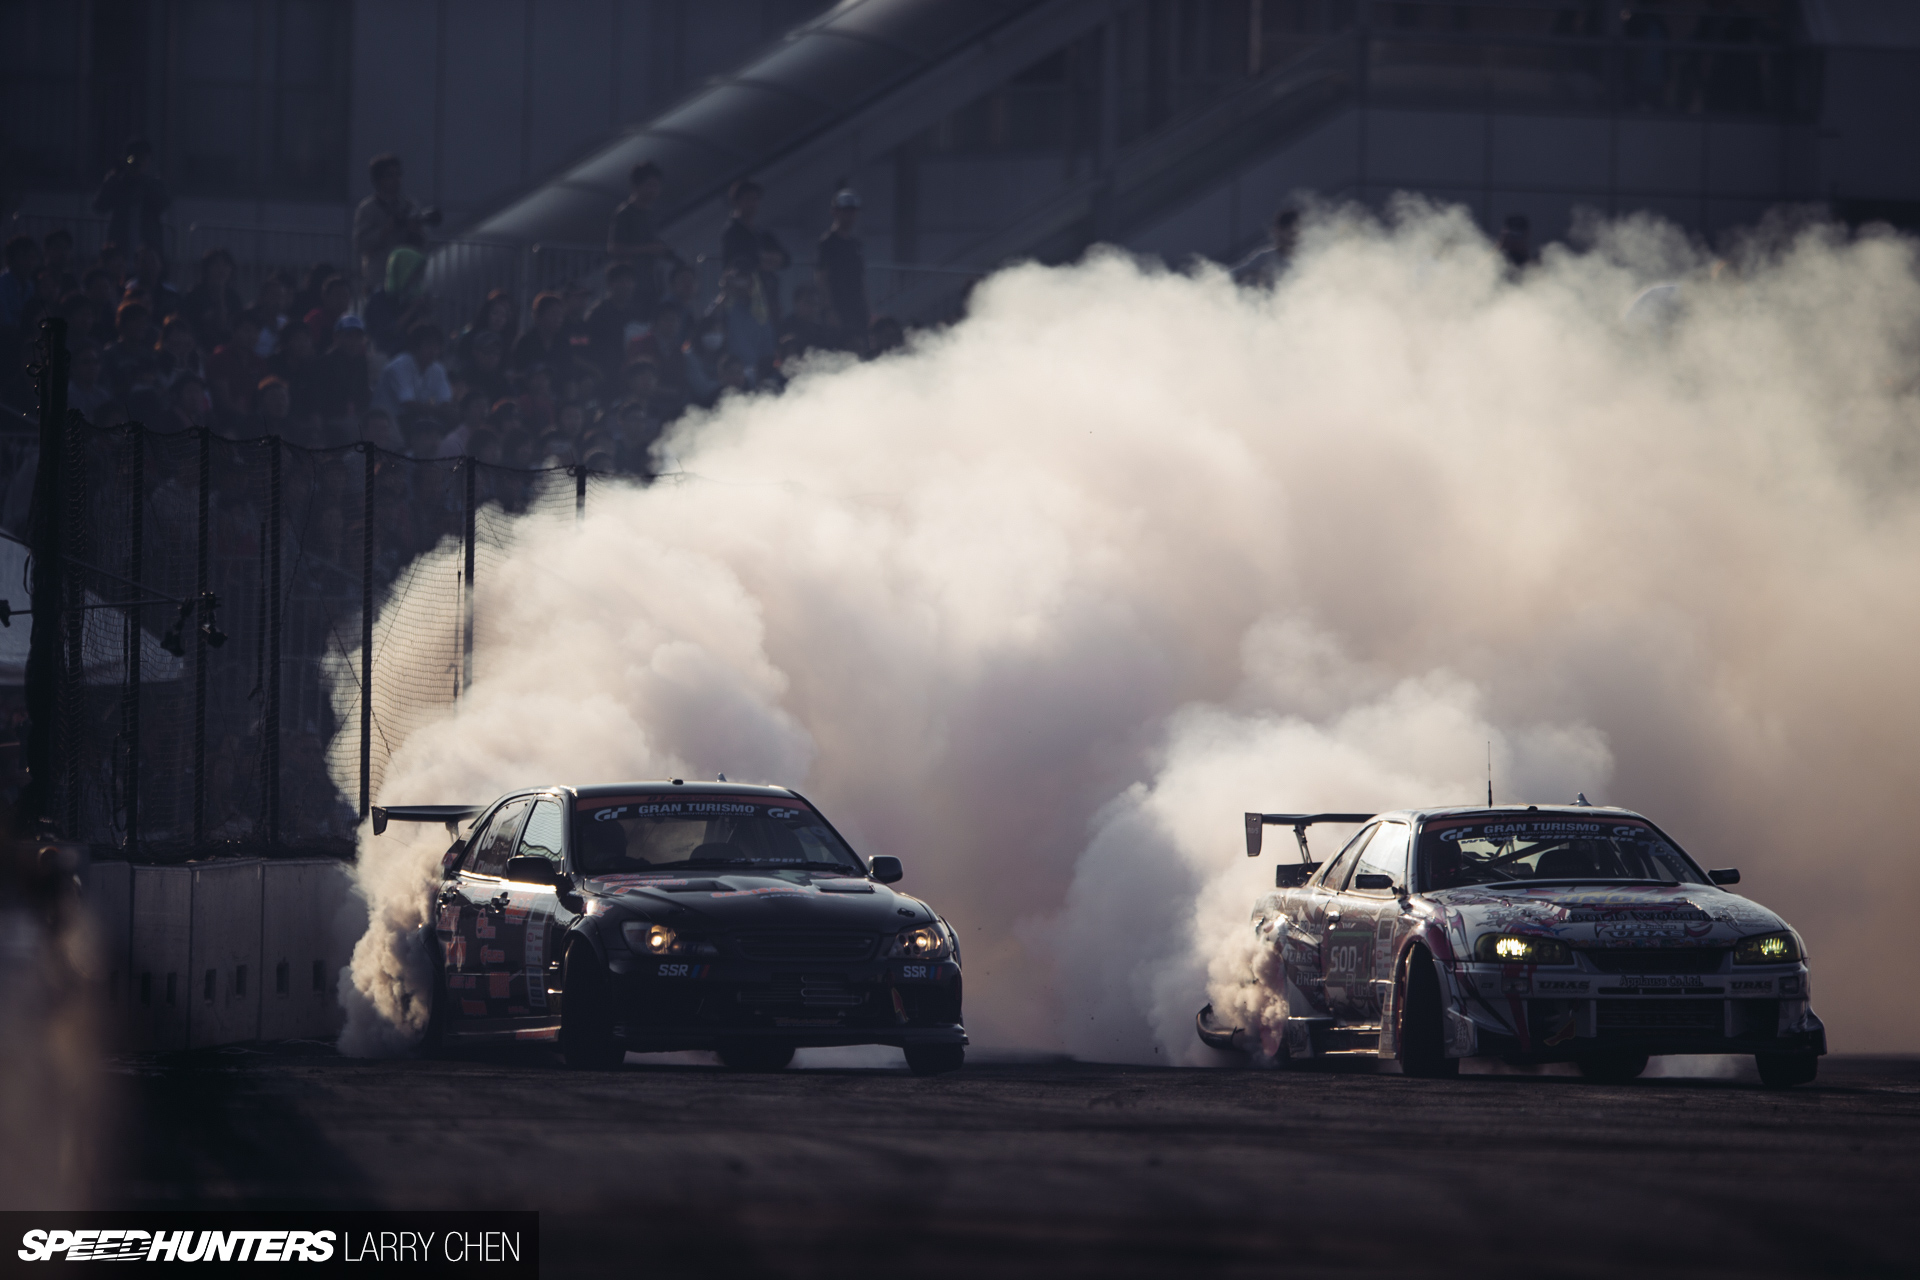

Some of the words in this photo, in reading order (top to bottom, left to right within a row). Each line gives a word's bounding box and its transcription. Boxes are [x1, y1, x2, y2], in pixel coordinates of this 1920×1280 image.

[638, 803, 682, 814] GRAN
[686, 802, 755, 813] TURISMO
[1483, 823, 1527, 834] GRAN
[1531, 822, 1600, 832] TURISMO
[657, 963, 689, 977] SSR
[903, 965, 927, 978] SSR
[1536, 980, 1591, 990] URAS
[1619, 974, 1667, 988] Applause
[1728, 980, 1774, 990] URAS
